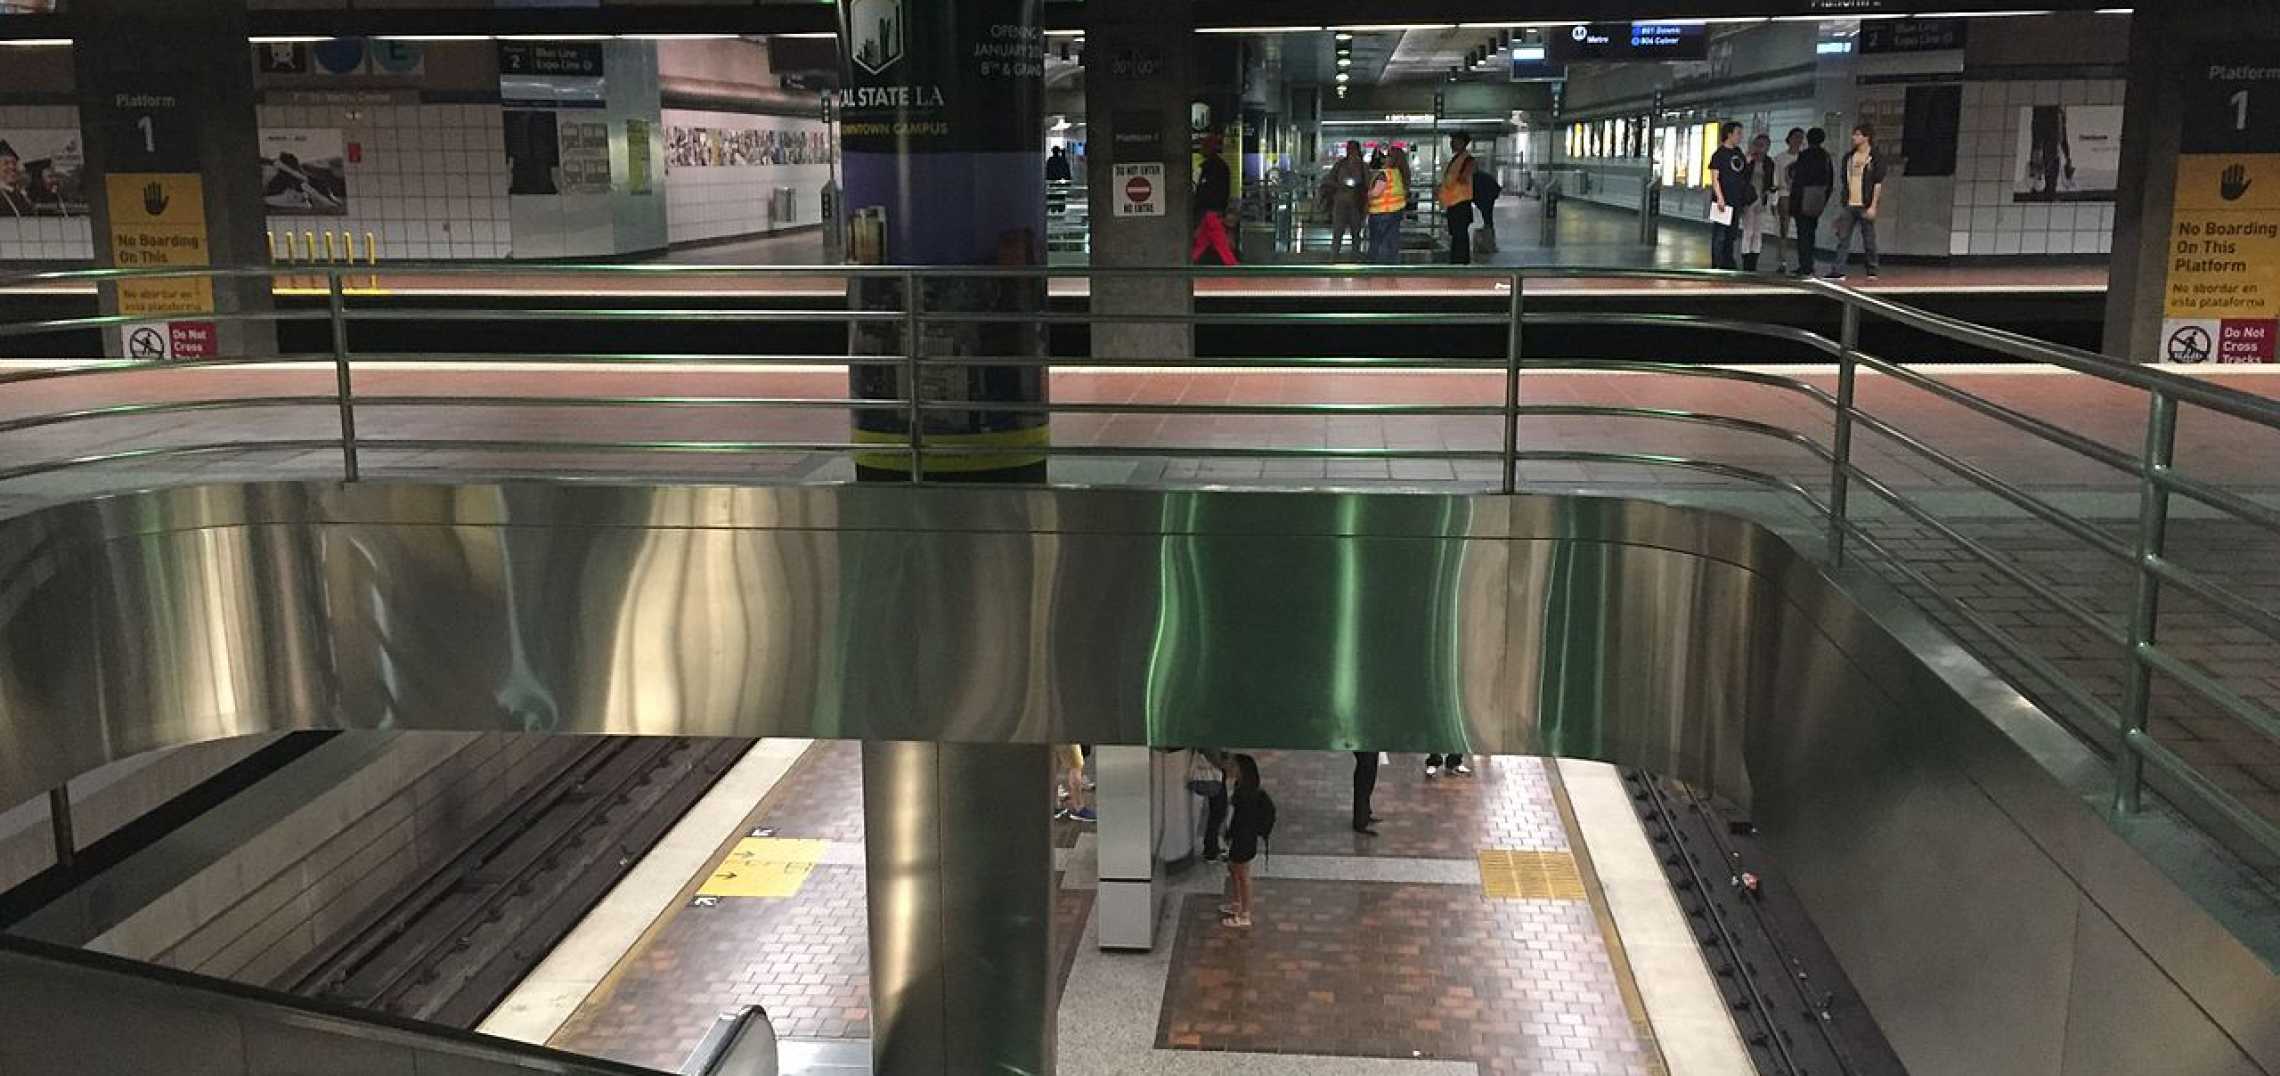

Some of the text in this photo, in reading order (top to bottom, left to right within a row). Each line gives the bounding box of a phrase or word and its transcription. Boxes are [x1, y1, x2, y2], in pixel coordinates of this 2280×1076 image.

[2208, 65, 2280, 80] Platform
[858, 86, 909, 107] STATE
[915, 86, 944, 107] LA
[2230, 89, 2249, 131] 1
[137, 115, 155, 153] 1
[2178, 222, 2278, 238] No Boarding
[118, 234, 199, 249] No Boarding
[2177, 240, 2236, 254] On This
[2175, 257, 2248, 273] Platform
[2223, 327, 2266, 339] Do Not
[2222, 341, 2259, 352] Cross
